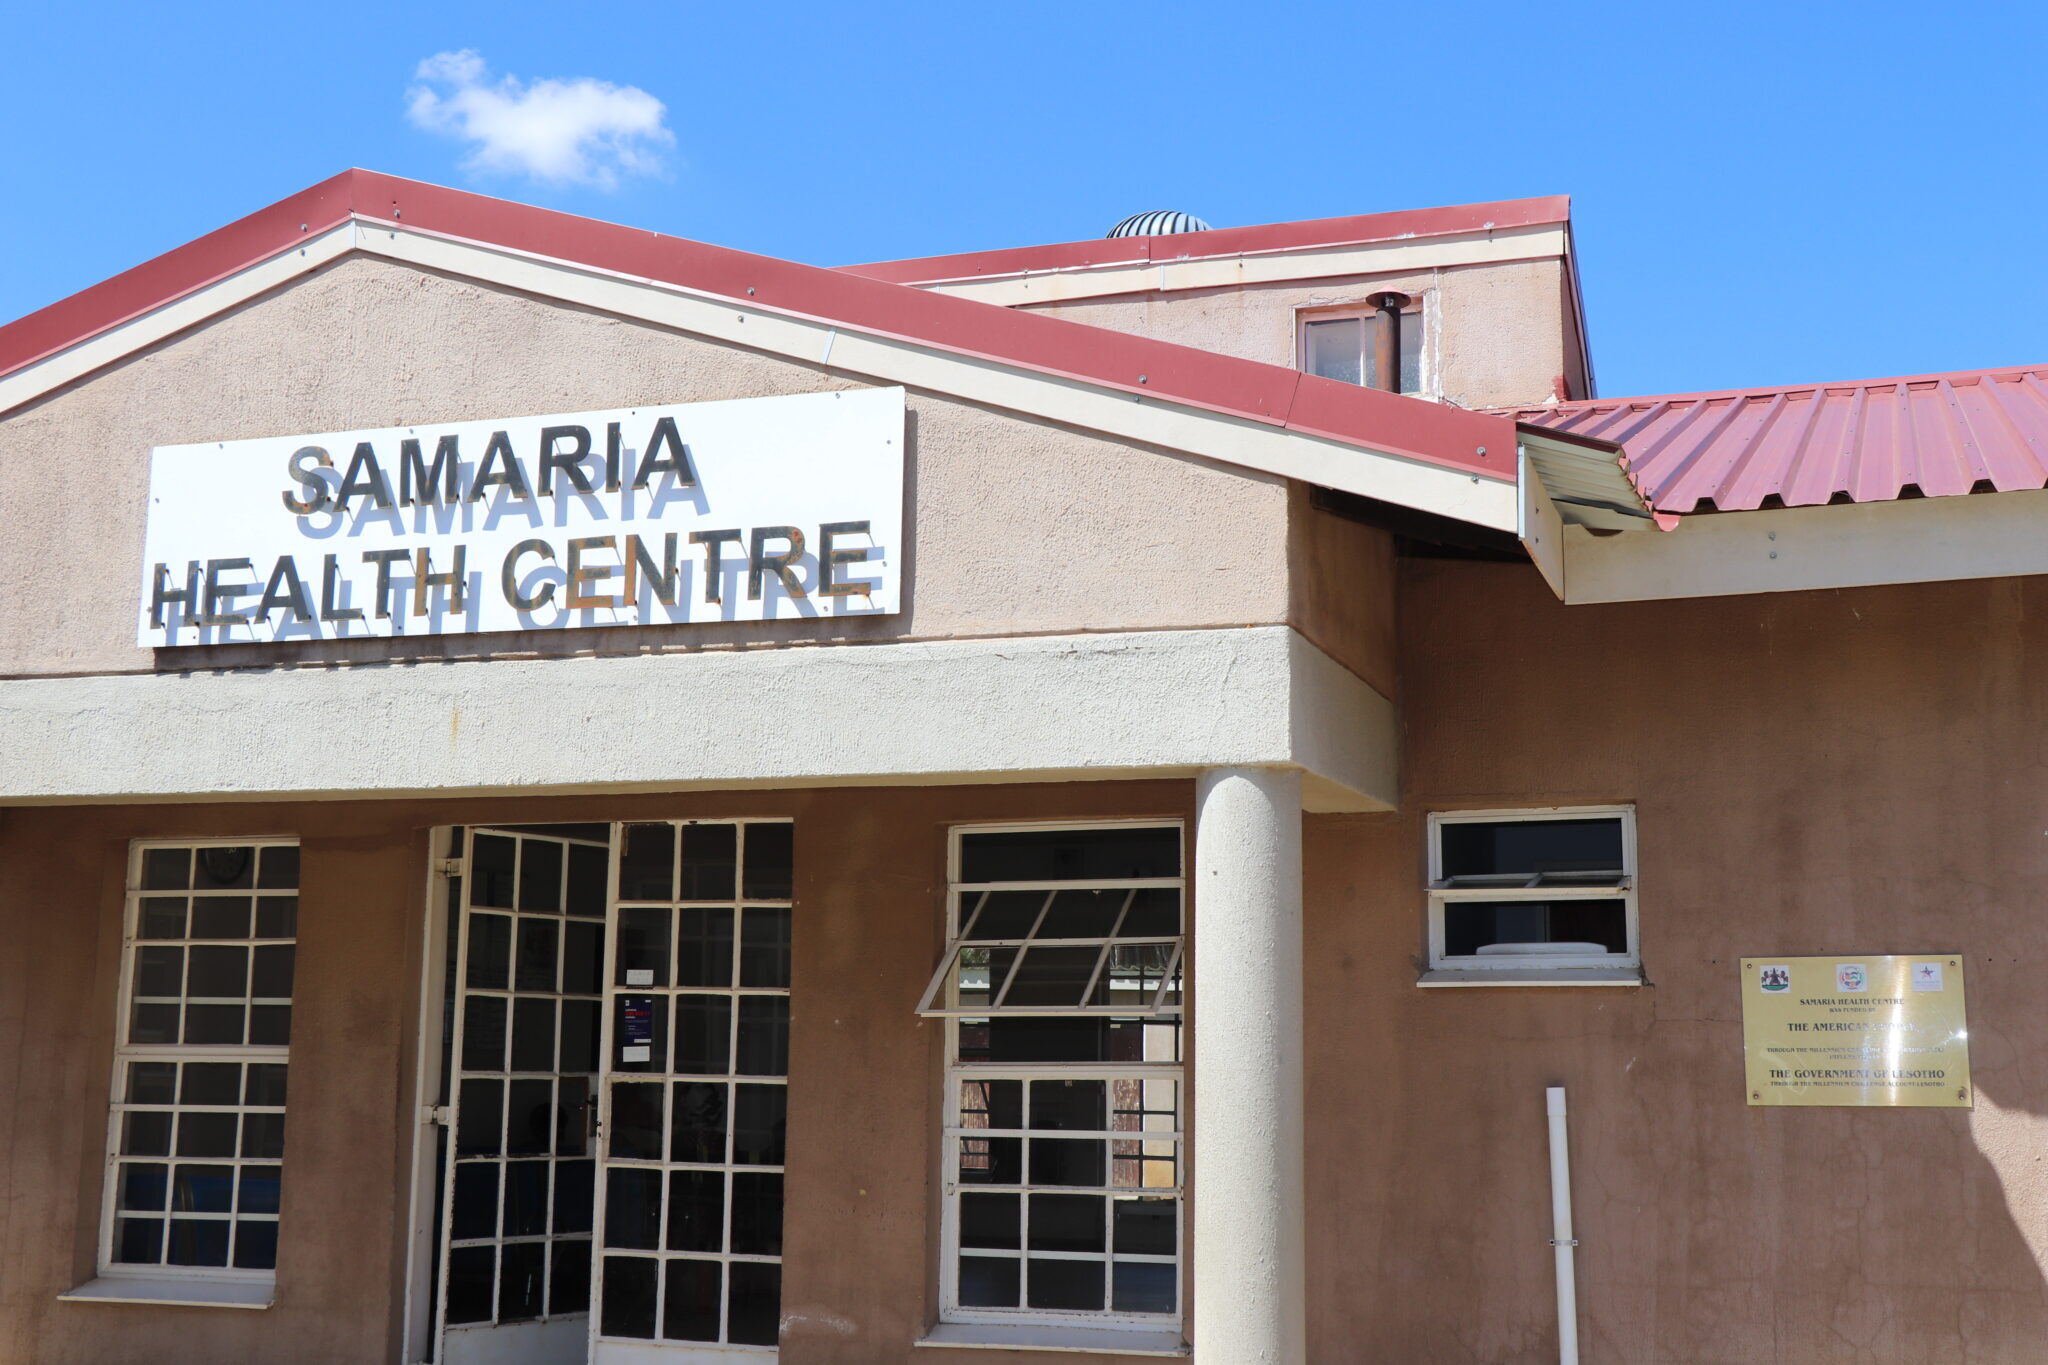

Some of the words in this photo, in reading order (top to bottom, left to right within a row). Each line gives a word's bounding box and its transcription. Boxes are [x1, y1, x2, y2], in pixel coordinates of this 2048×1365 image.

[281, 415, 696, 515] SAMARIA
[150, 544, 468, 630] HEALTH
[501, 520, 872, 612] CENTRE
[1799, 998, 1836, 1006] SAMARIA
[1838, 998, 1870, 1006] HEALTH
[1872, 997, 1905, 1005] CENTRE
[1787, 1022, 1810, 1032] THE
[1812, 1022, 1869, 1032] AMERICAN
[1769, 1069, 1792, 1079] THE
[1794, 1069, 1870, 1079] GOVERNMENT
[1873, 1069, 1889, 1079] OF
[1892, 1069, 1946, 1079] LESOTHO
